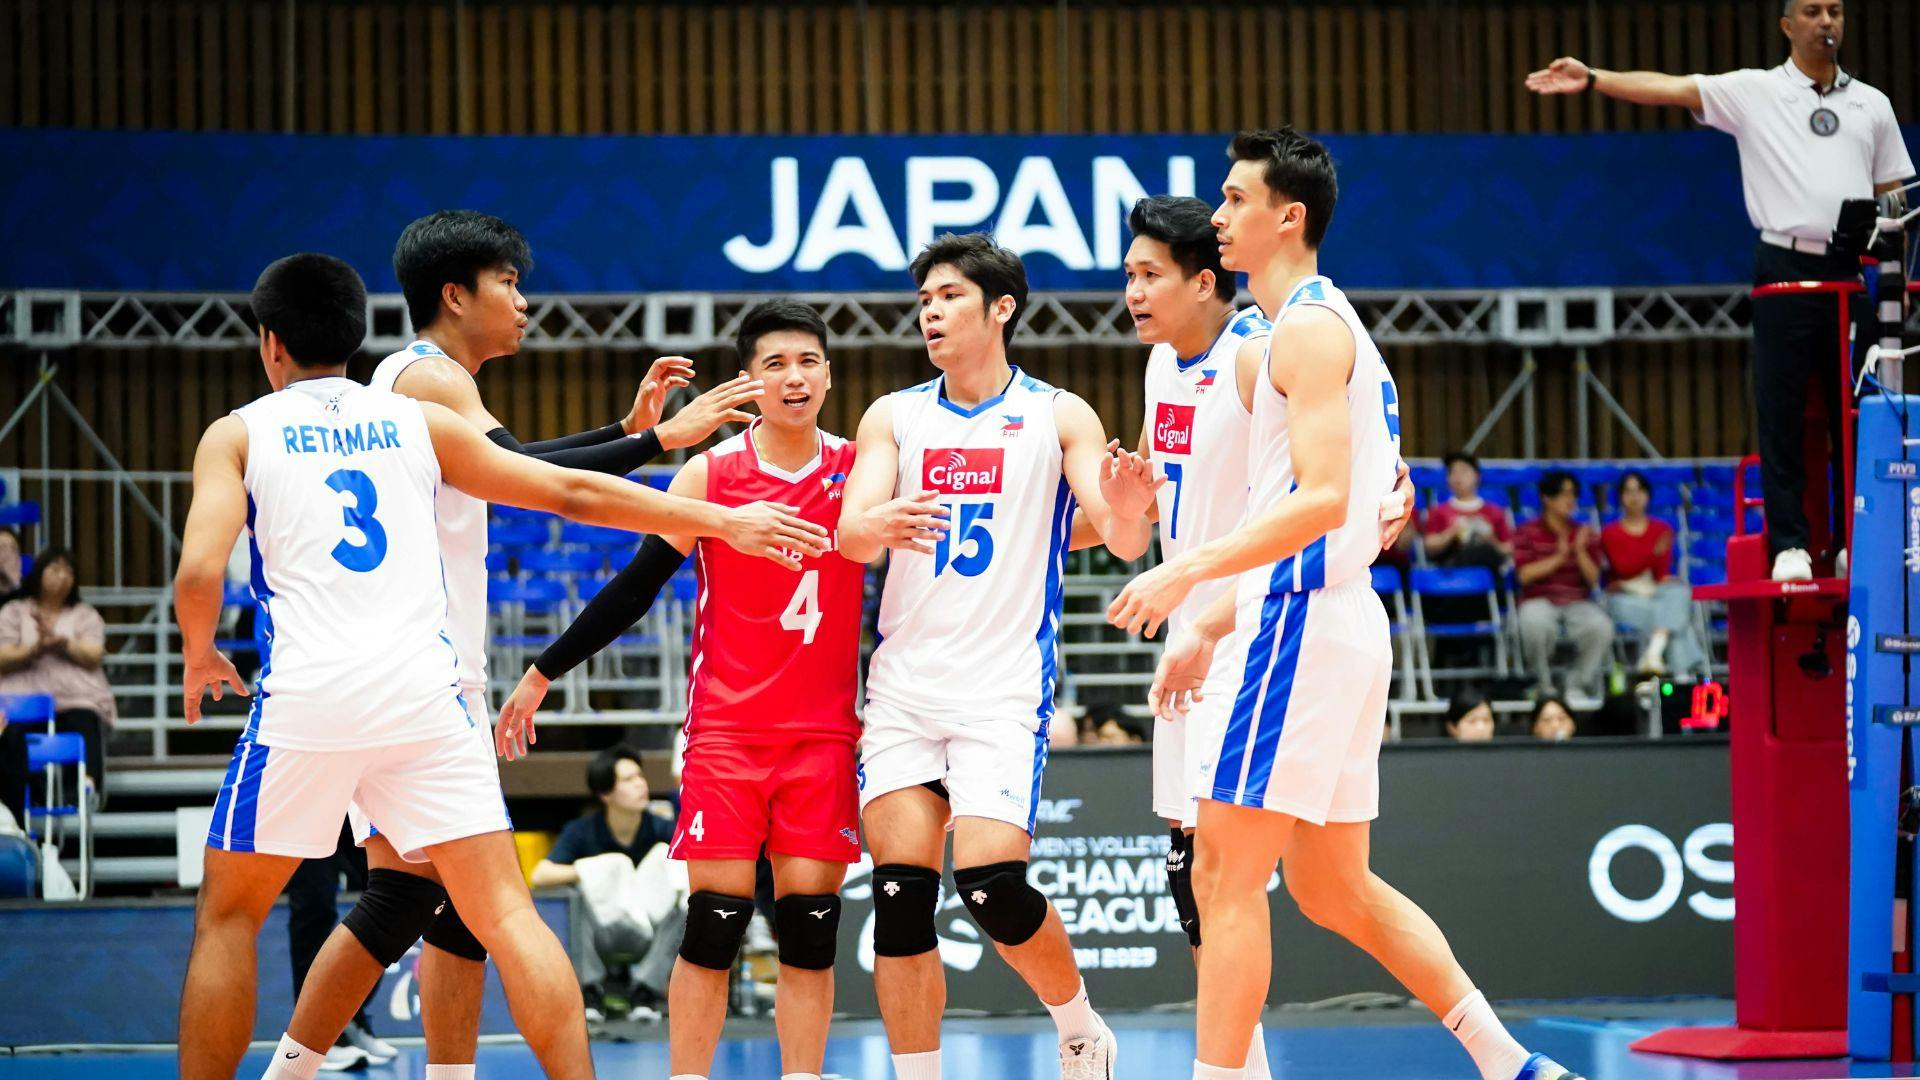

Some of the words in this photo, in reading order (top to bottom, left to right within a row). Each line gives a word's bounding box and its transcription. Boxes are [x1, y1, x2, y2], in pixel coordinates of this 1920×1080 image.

[723, 156, 1196, 273] JAPAN
[283, 420, 401, 457] RETAMAR
[1003, 430, 1019, 438] PHI
[1157, 422, 1189, 449] Cignal
[828, 490, 842, 501] PH
[929, 465, 997, 491] Cignal
[1164, 462, 1183, 539] 7
[325, 469, 388, 573] 3
[930, 503, 995, 578] 15
[779, 570, 823, 645] 4
[689, 811, 704, 841] 4
[1052, 896, 1185, 935] EAGUE
